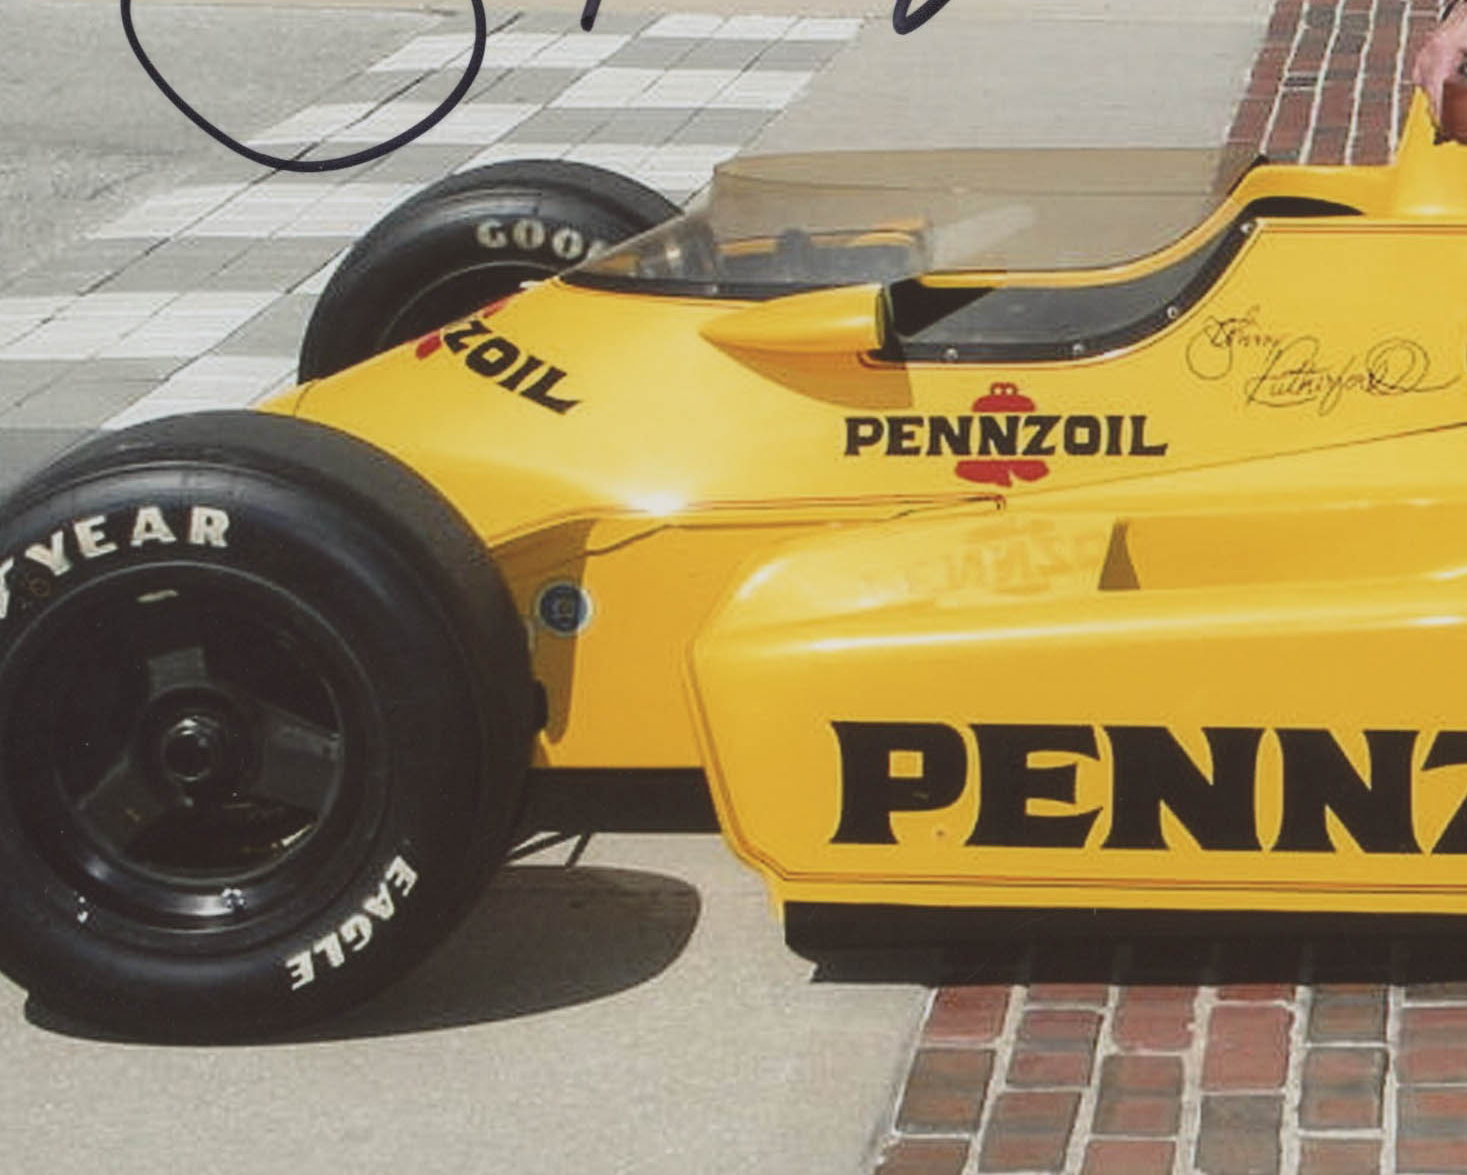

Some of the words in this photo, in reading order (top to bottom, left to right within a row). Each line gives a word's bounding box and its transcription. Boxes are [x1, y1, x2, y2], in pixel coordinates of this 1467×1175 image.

[443, 320, 583, 416] ZOIL
[844, 415, 1168, 457] PENNZOIL
[285, 854, 419, 992] EAGLE
